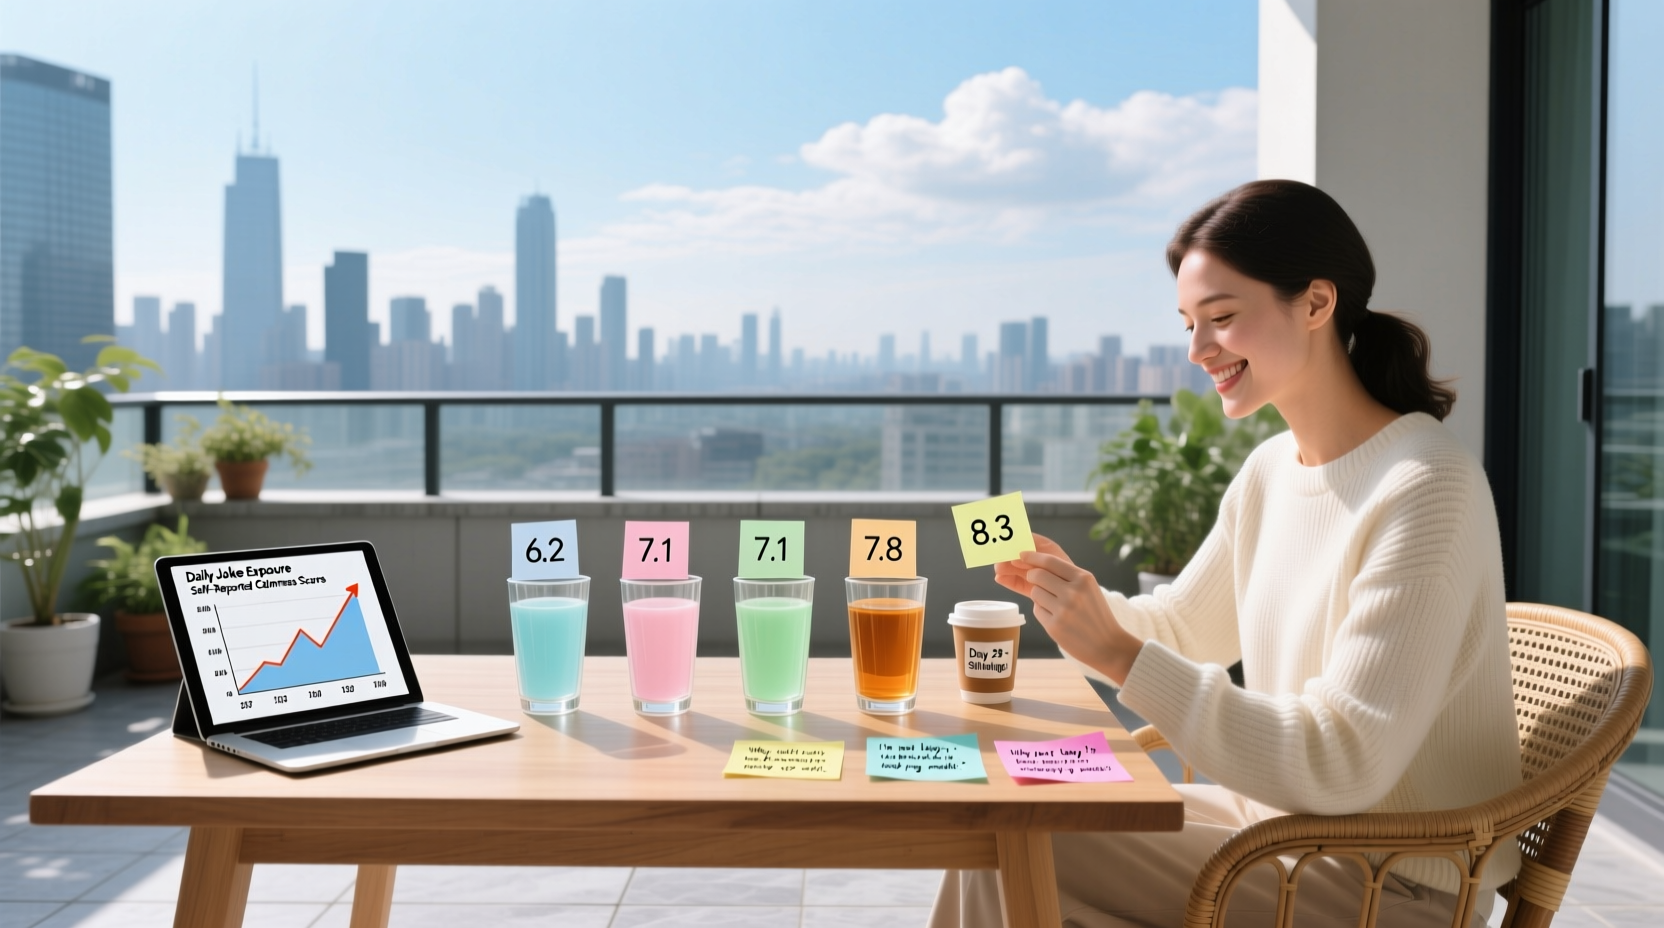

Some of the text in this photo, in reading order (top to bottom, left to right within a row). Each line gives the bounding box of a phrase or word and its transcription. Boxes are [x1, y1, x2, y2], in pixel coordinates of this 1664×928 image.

[970, 514, 1014, 546] 8.3
[525, 537, 565, 564] 6.2
[638, 537, 671, 563] 7.1
[754, 536, 787, 562] 7.1
[864, 535, 903, 562] 7.8
[216, 566, 245, 580] Joke
[969, 647, 989, 661] Day
